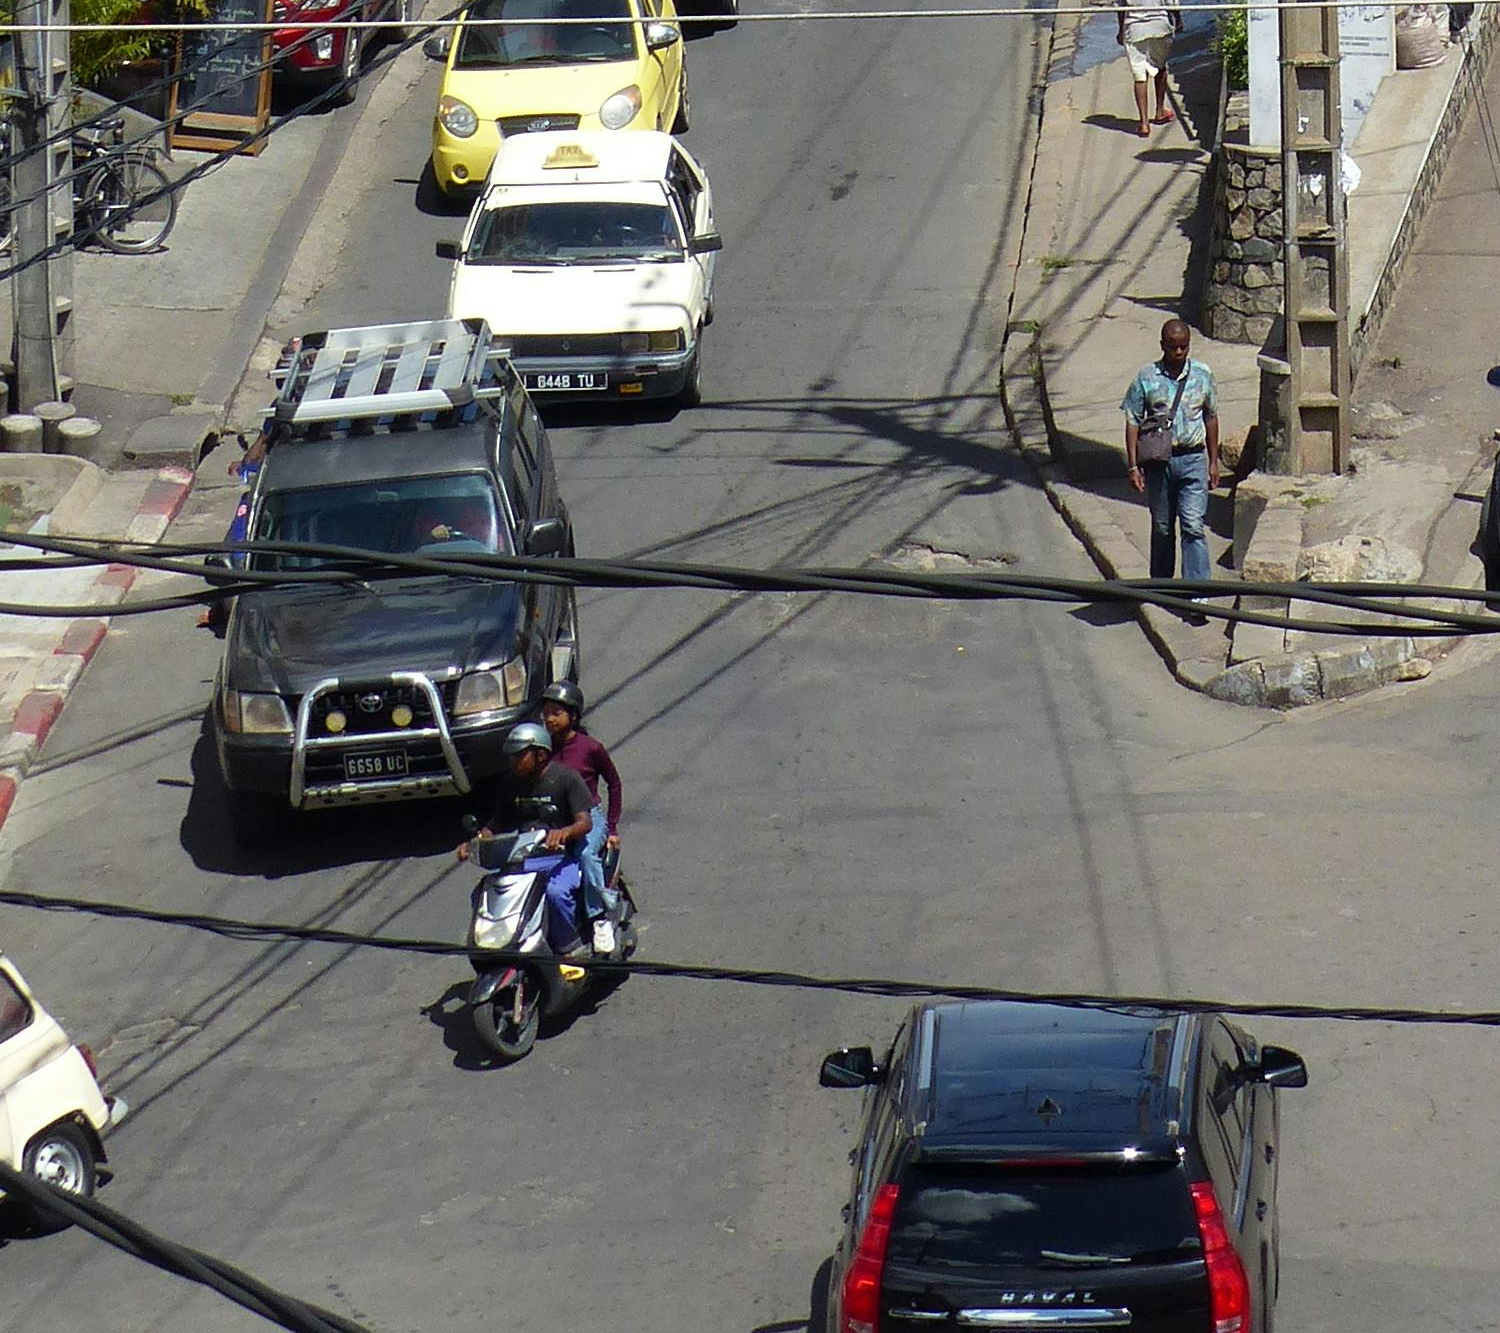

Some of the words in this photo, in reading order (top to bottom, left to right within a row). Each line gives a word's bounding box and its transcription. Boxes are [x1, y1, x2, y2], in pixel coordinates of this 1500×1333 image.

[577, 374, 594, 387] TU
[348, 757, 383, 775] 6658
[386, 755, 404, 771] UC
[1001, 1292, 1095, 1304] HAVAL
